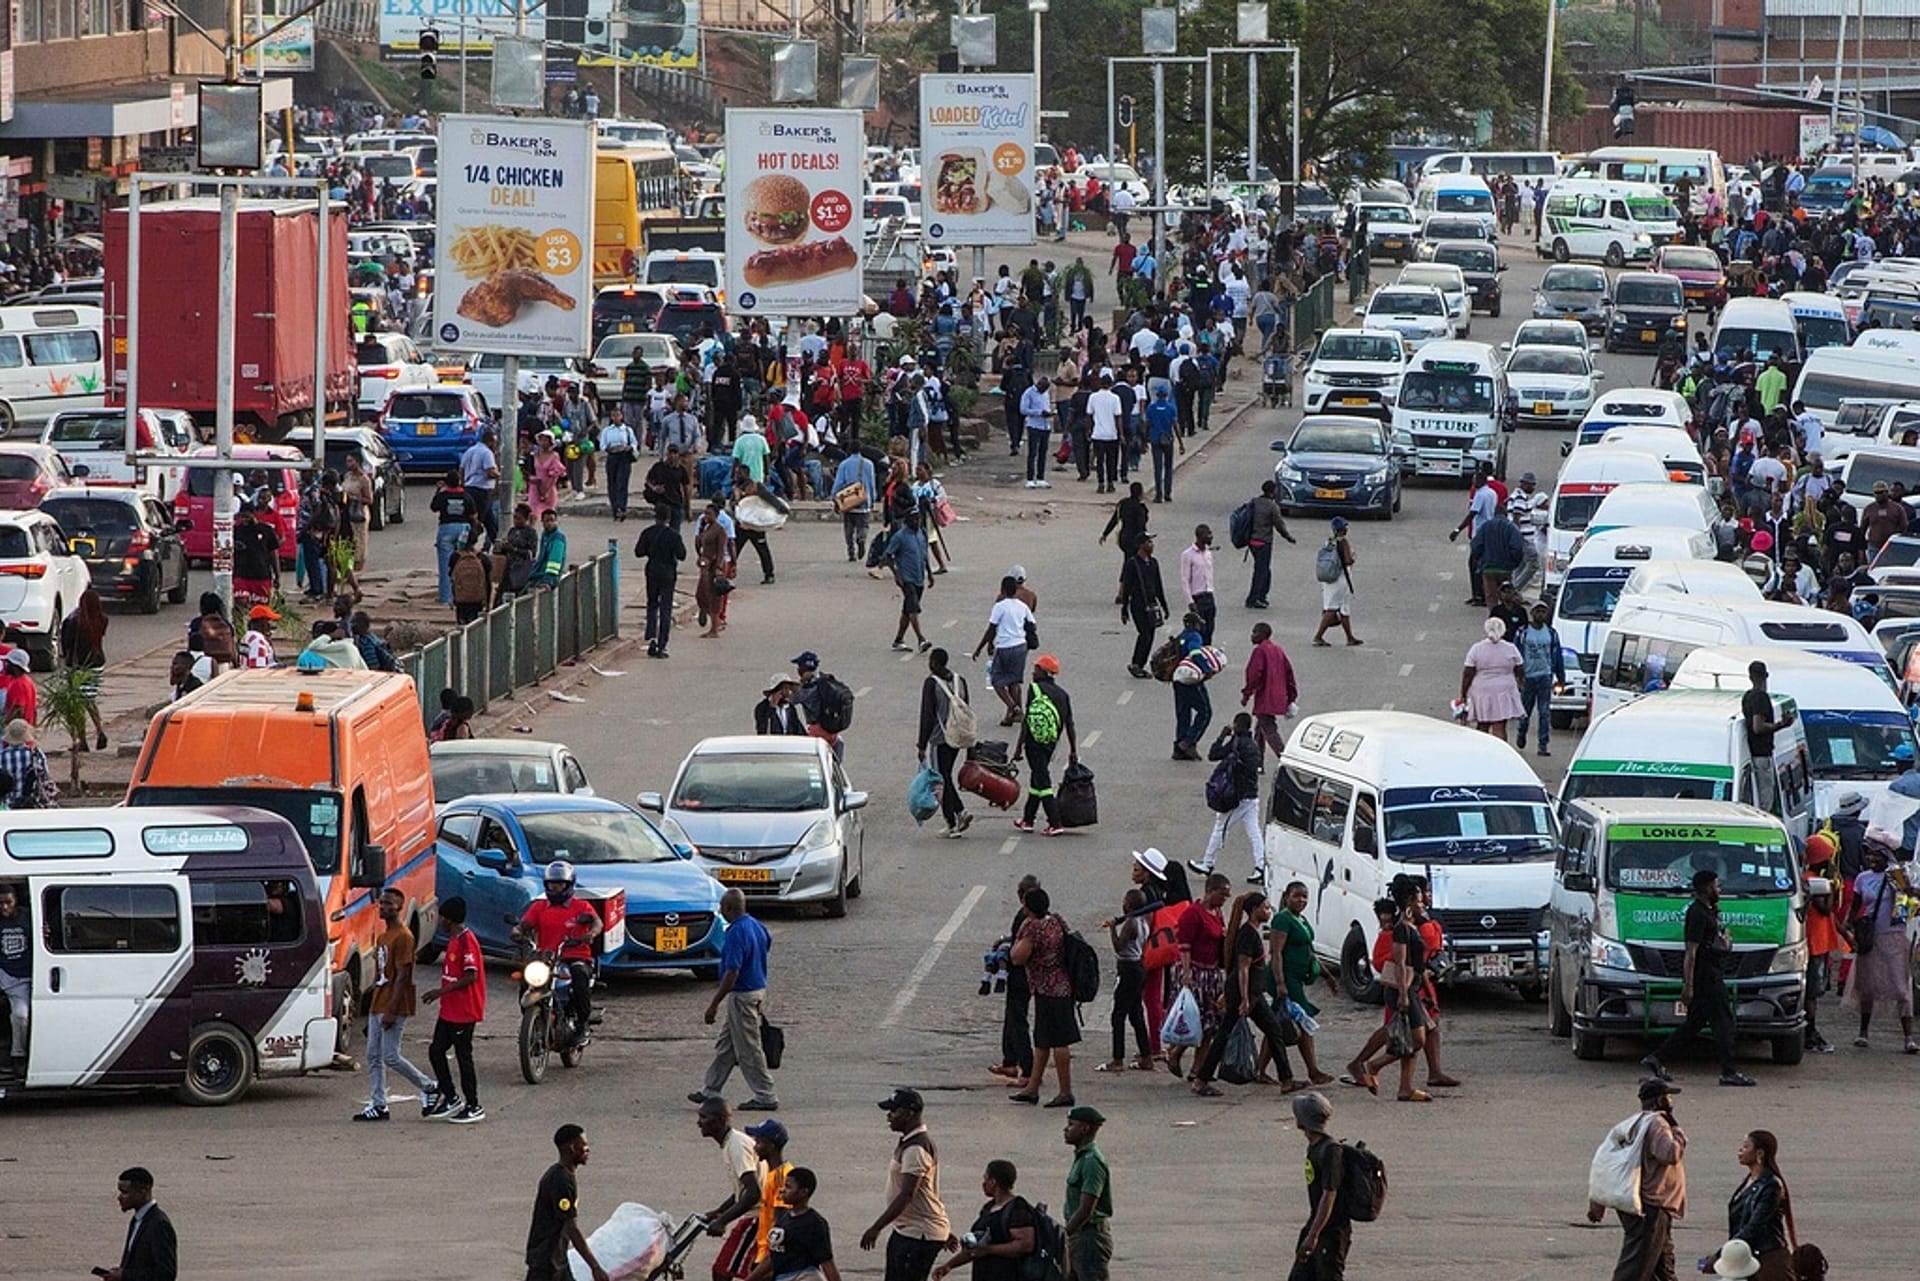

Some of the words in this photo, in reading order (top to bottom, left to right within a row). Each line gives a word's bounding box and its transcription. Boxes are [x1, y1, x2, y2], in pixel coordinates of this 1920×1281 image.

[929, 106, 980, 122] LOADED
[773, 124, 831, 137] BAKER'S
[486, 133, 552, 149] BAKER'S
[533, 148, 557, 157] INN
[757, 153, 787, 169] HOT
[792, 153, 839, 170] DEALS!
[464, 164, 490, 183] 1/4
[496, 166, 563, 188] CHICKEN
[491, 187, 536, 207] DEAL!
[546, 235, 568, 245] USD
[546, 247, 572, 269] $3
[1411, 419, 1478, 433] FUTURE
[148, 832, 175, 845] The
[1642, 828, 1717, 838] LONGAZ
